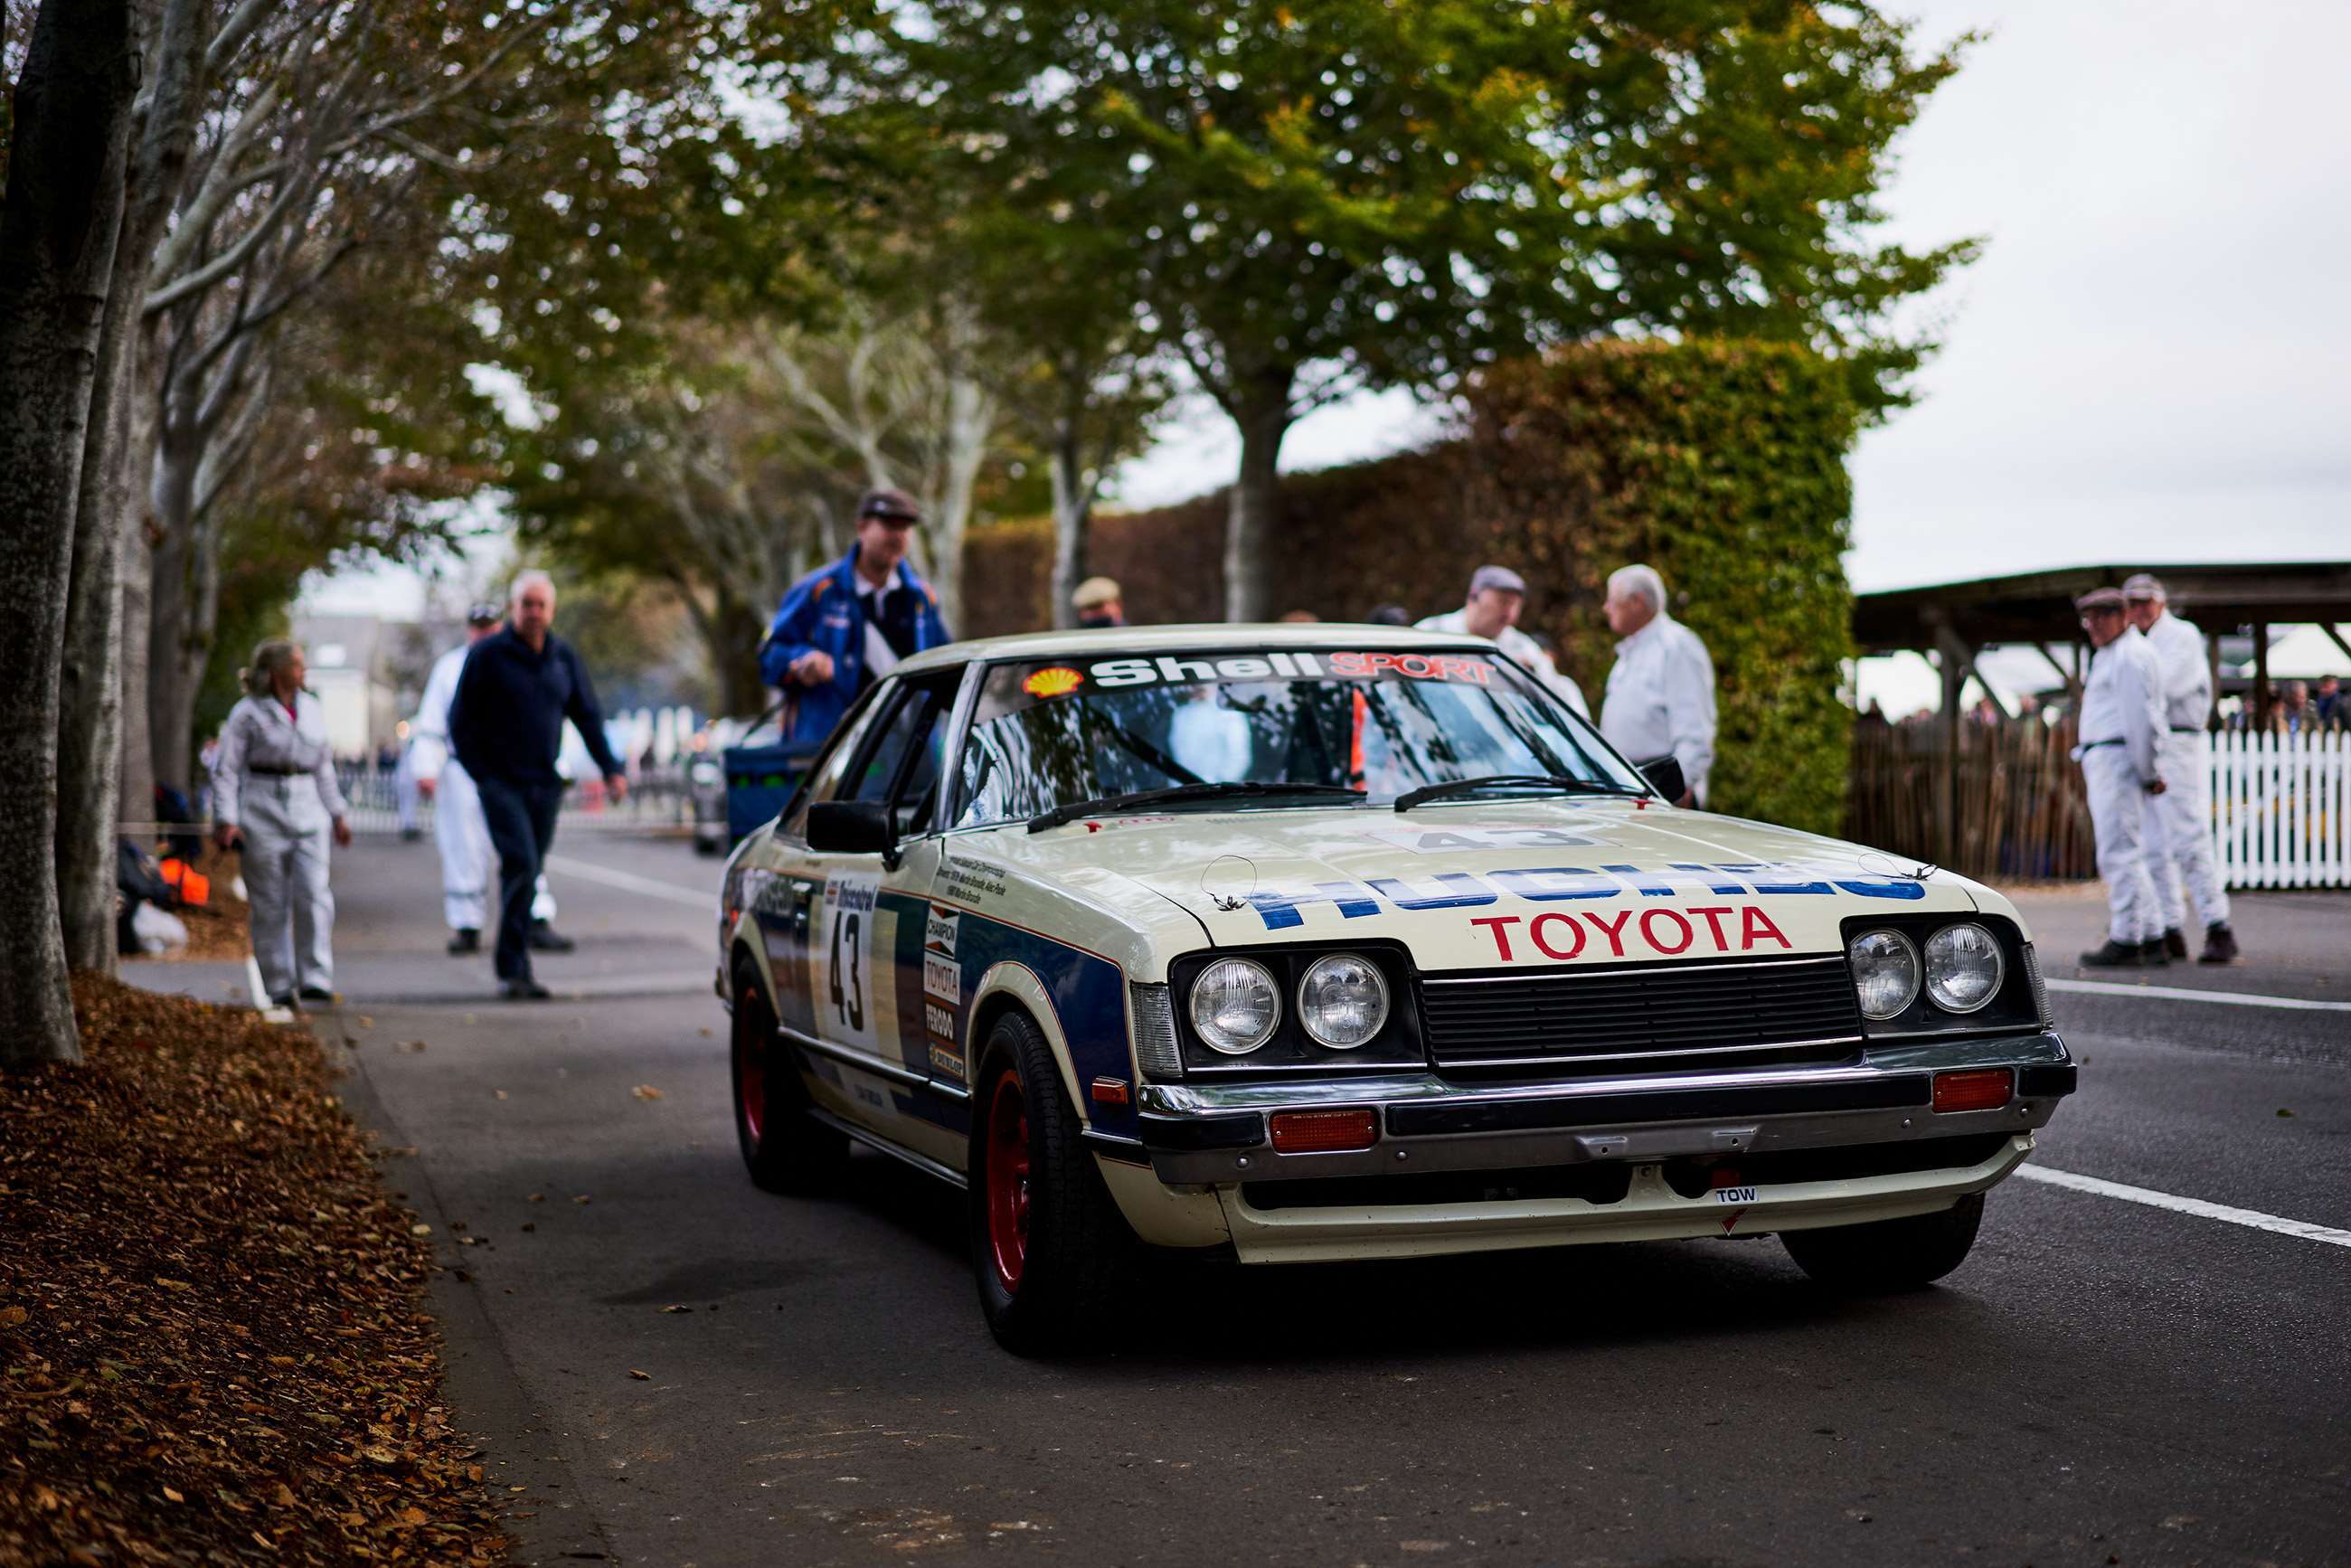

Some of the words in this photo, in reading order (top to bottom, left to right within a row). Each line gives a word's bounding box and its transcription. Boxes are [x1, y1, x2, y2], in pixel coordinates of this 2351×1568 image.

[1091, 652, 1324, 687] Shell
[1329, 651, 1497, 685] SPORT
[1417, 828, 1594, 848] 43
[1247, 863, 1925, 930] HUGHES
[927, 919, 957, 941] CHAMPION
[1470, 906, 1792, 961] TOYOTA
[829, 911, 864, 1032] 43
[926, 960, 958, 997] TOYOTA
[926, 1003, 954, 1040] FERODO
[937, 1052, 963, 1072] DUNLOP
[1716, 1188, 1755, 1202] TOW
